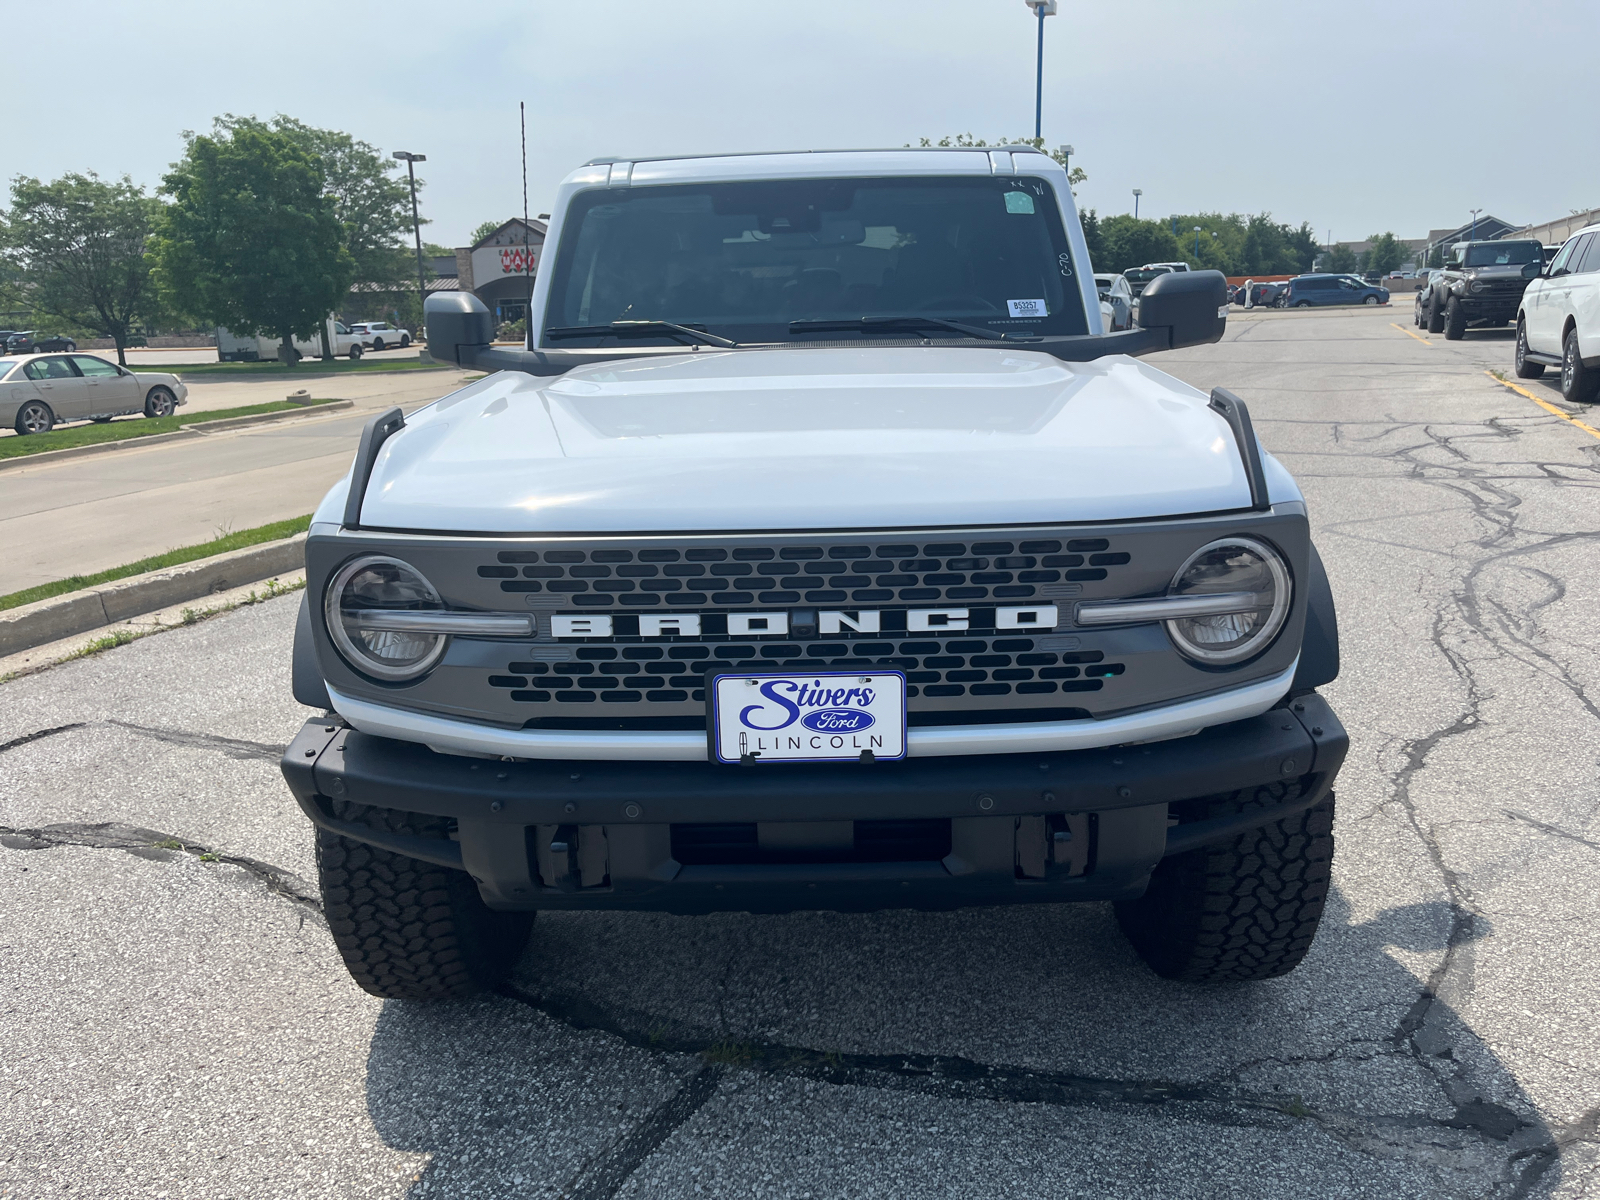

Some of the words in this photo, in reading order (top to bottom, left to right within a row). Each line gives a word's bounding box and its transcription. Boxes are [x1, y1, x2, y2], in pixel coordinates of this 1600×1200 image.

[499, 248, 535, 256] EARL
[1058, 252, 1072, 277] C-70
[550, 604, 1058, 638] BRONCO
[739, 680, 876, 731] Stivers
[816, 711, 859, 729] Ford
[758, 735, 883, 750] LINCOLN
